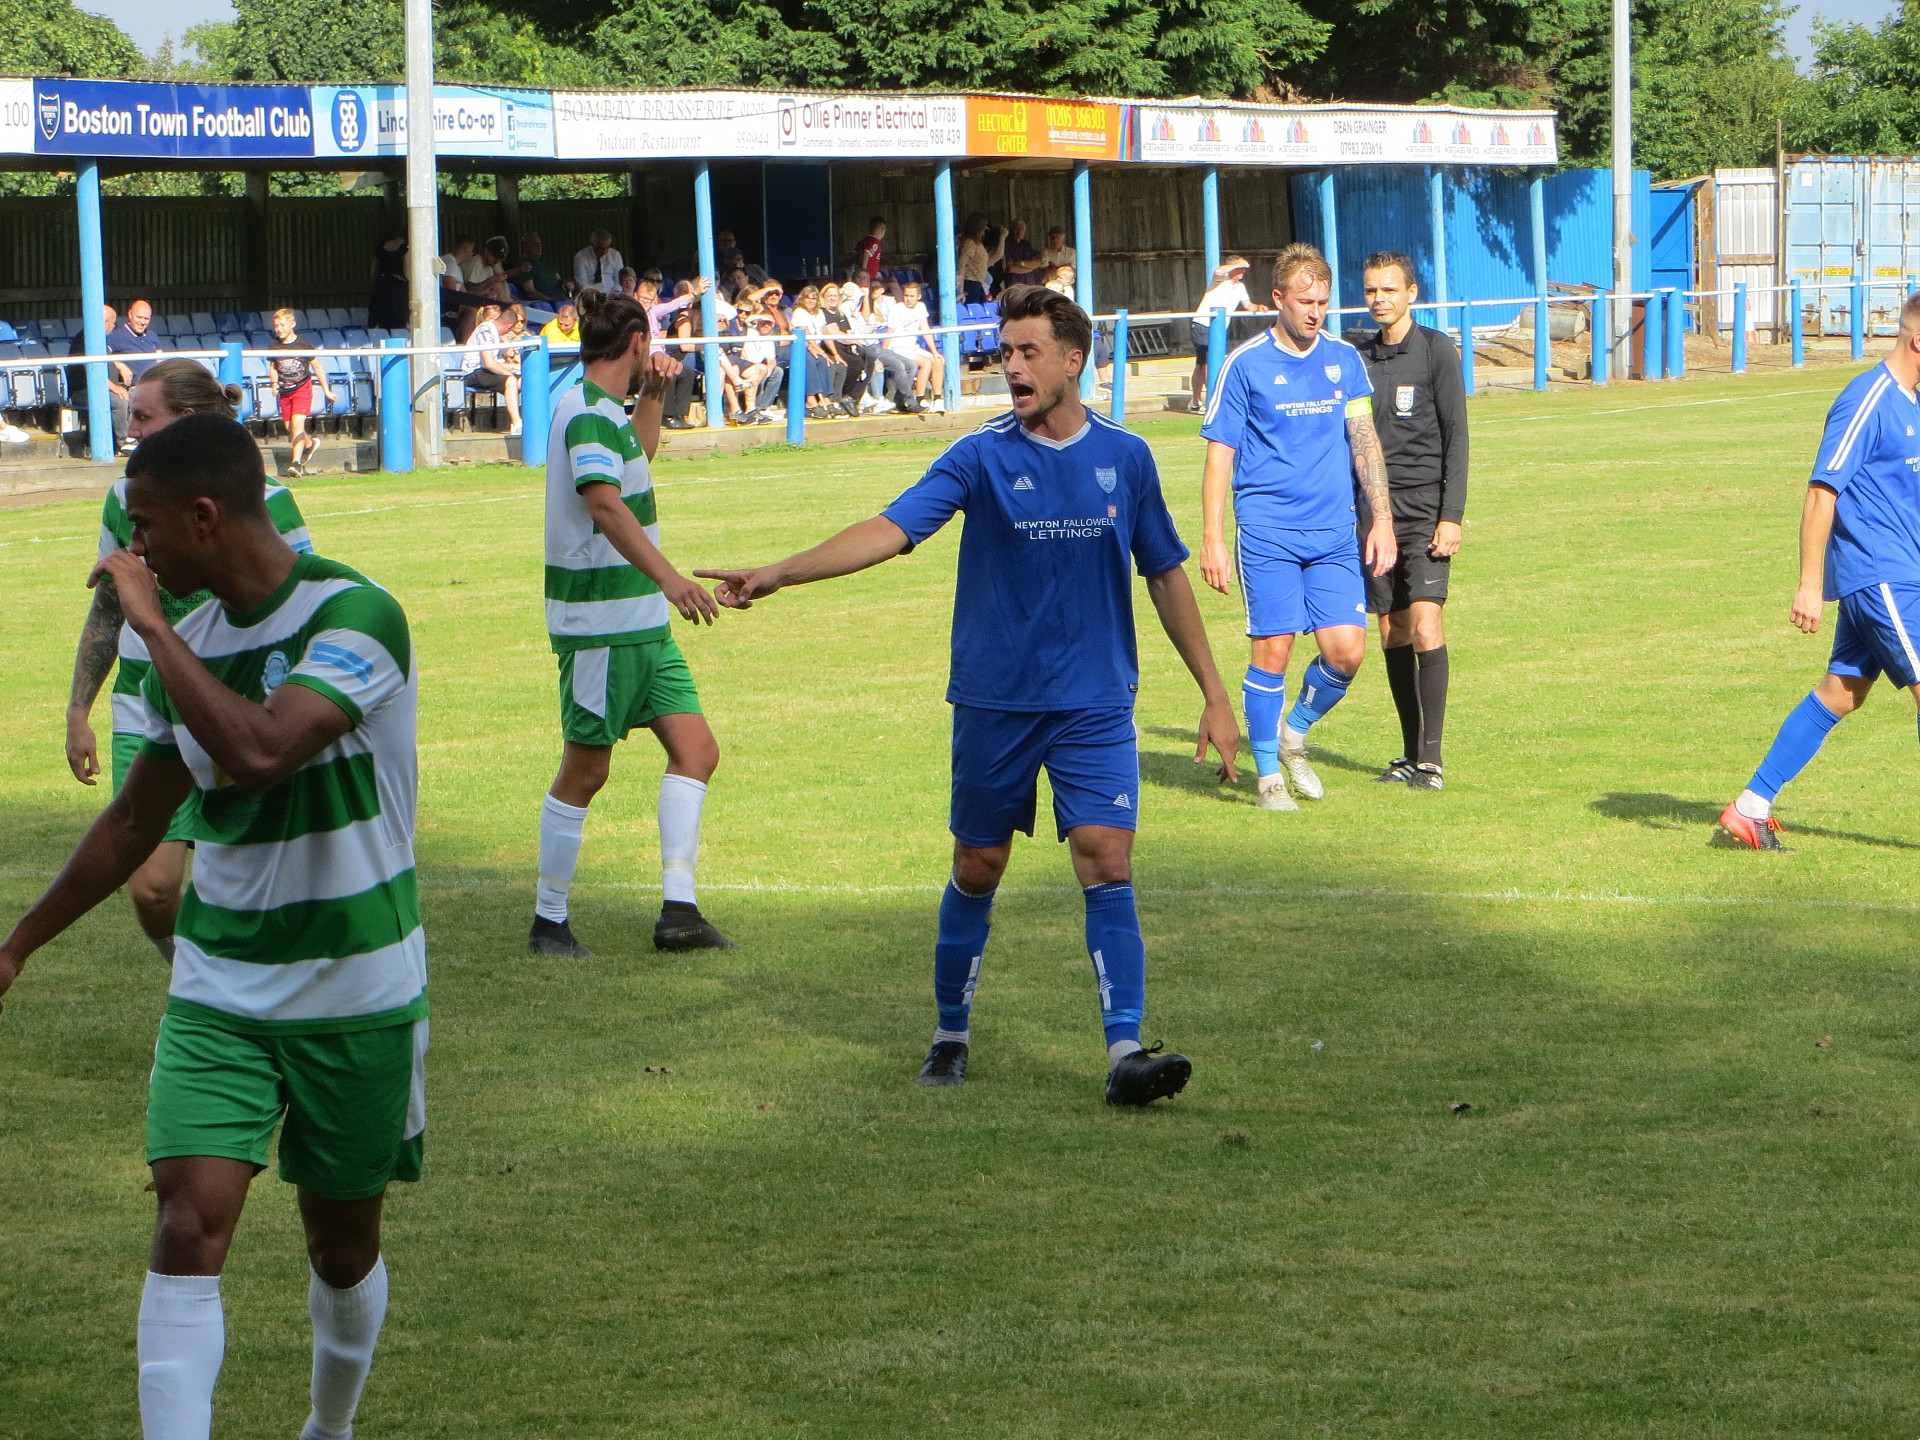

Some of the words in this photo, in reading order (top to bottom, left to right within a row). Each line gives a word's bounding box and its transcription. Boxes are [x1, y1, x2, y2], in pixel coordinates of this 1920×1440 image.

[64, 101, 132, 135] Boston
[136, 104, 188, 136] Town
[192, 105, 266, 137] Football
[270, 106, 311, 137] Club
[561, 100, 636, 121] BOMBAY
[640, 100, 735, 120] BRASSERIE
[803, 102, 830, 129] Ollie
[834, 103, 872, 129] Pinner
[876, 103, 928, 129] Electrical
[933, 107, 957, 122] 07788
[1046, 105, 1073, 128] 01205
[1075, 107, 1106, 130] 366303
[458, 108, 495, 135] Co-op
[978, 113, 1014, 132] ELECTRIC
[1334, 120, 1352, 134] DEAN
[1353, 120, 1387, 134] GRAINGER
[598, 128, 636, 150] Indian
[640, 132, 702, 150] Restaurant
[930, 129, 945, 144] 988
[947, 129, 961, 144] 439
[997, 134, 1027, 152] CENTER
[1275, 402, 1305, 410] NEWTON
[1306, 399, 1342, 408] FALLOWELL
[1286, 406, 1333, 417] LETTINGS
[1014, 520, 1059, 530] NEWTON
[1063, 517, 1116, 527] FALLOWELL
[1030, 527, 1102, 540] LETTINGS
